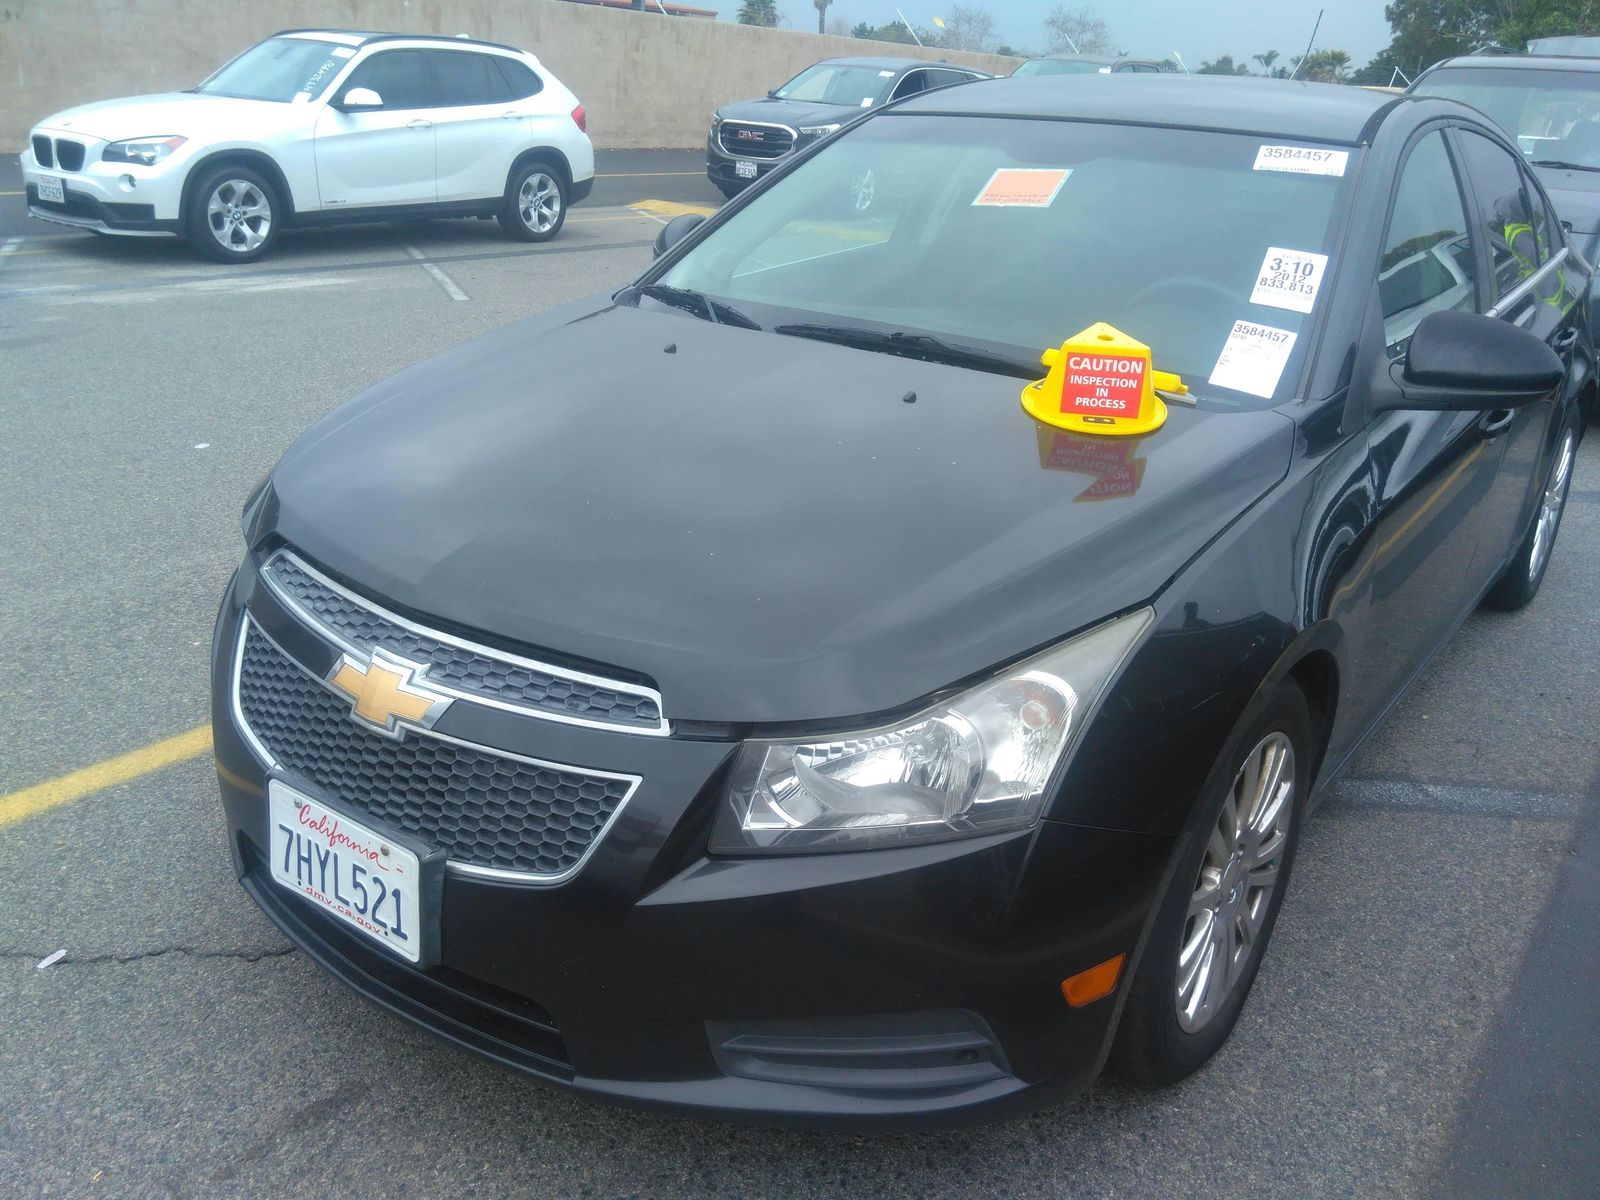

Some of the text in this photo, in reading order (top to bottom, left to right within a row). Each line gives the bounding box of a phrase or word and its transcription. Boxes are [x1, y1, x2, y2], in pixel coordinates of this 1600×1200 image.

[738, 130, 764, 141] GMC
[1263, 147, 1333, 162] 3584457
[1270, 257, 1314, 277] 3:10
[1273, 271, 1306, 284] 2012
[1234, 323, 1289, 343] 3584457
[1069, 356, 1144, 374] CAUTION
[1070, 374, 1138, 389] INSPECTION
[1096, 387, 1109, 397] IN
[1075, 397, 1126, 409] PROCESS
[299, 803, 390, 872] California
[278, 823, 409, 941] 7HYL521
[305, 886, 381, 935] dmv.ca.gov
